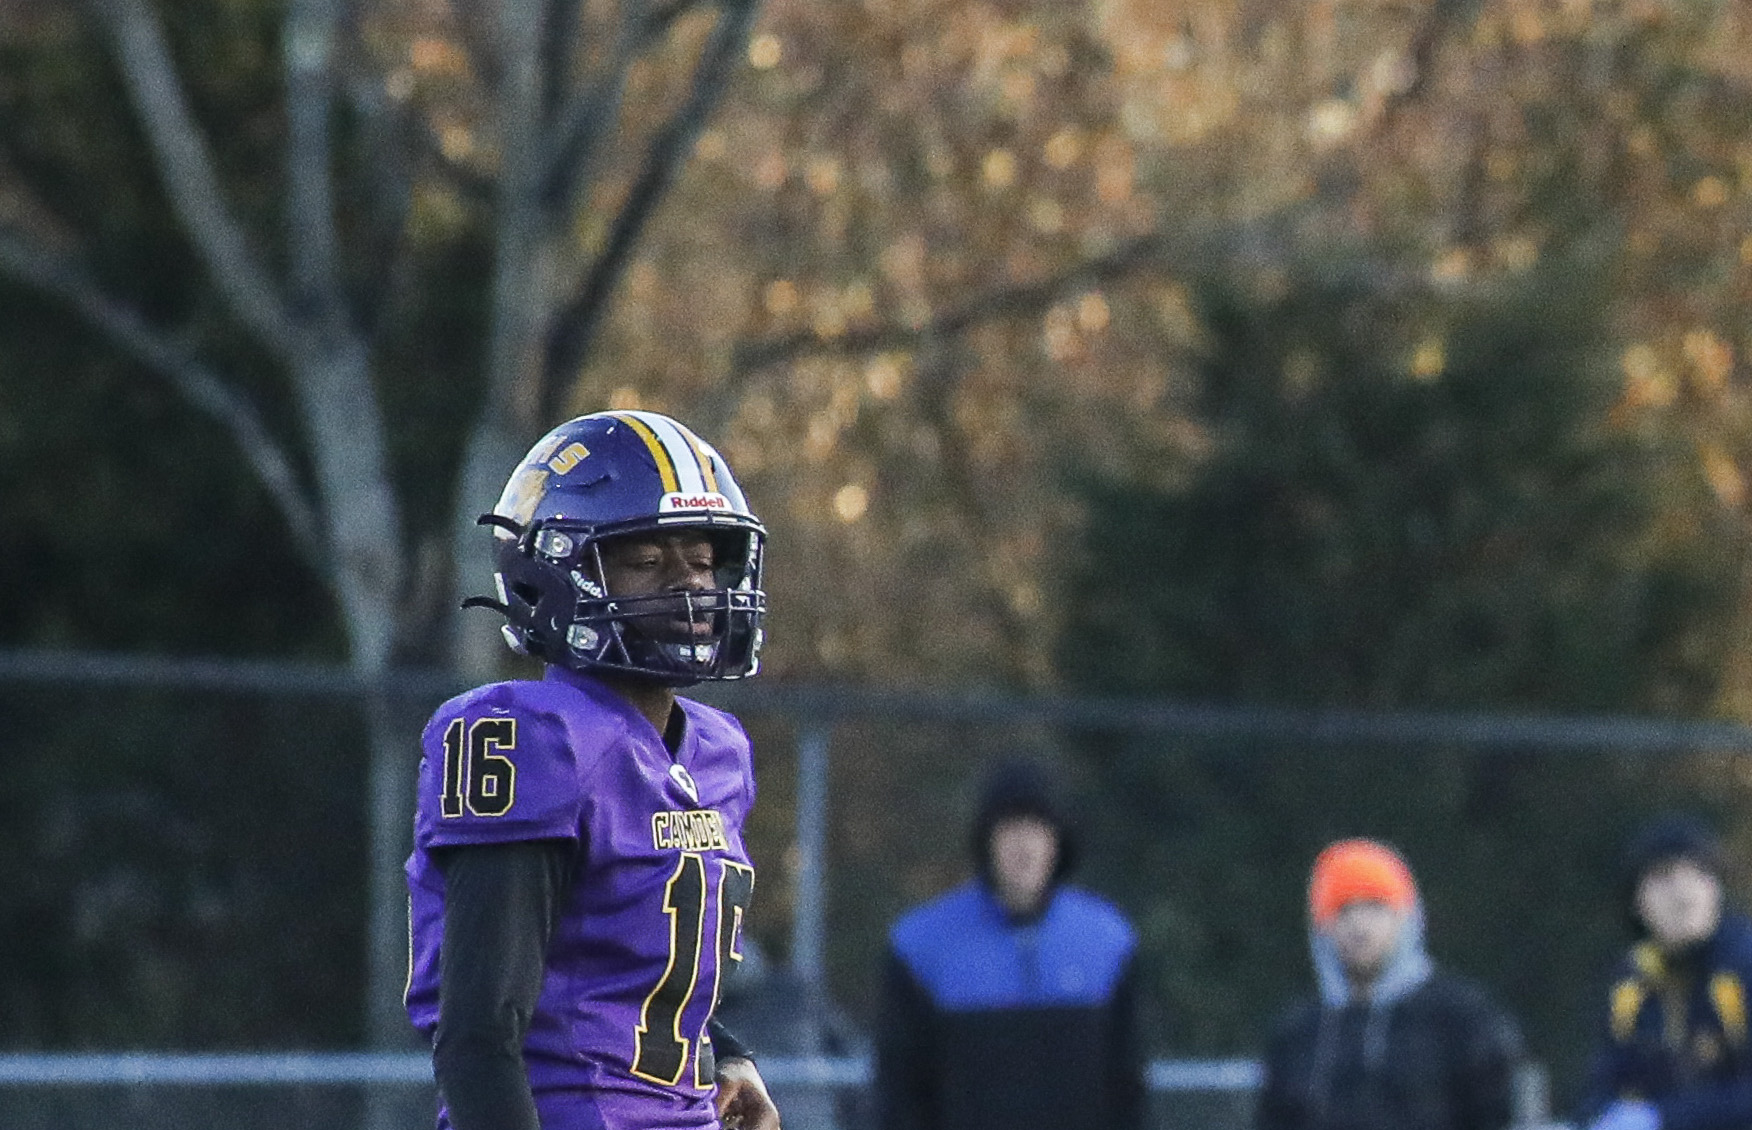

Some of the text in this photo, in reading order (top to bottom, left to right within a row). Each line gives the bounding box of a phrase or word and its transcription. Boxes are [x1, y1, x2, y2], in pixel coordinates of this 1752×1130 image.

[671, 496, 724, 508] Riddell
[439, 717, 517, 818] 16
[652, 809, 729, 851] CAMDE
